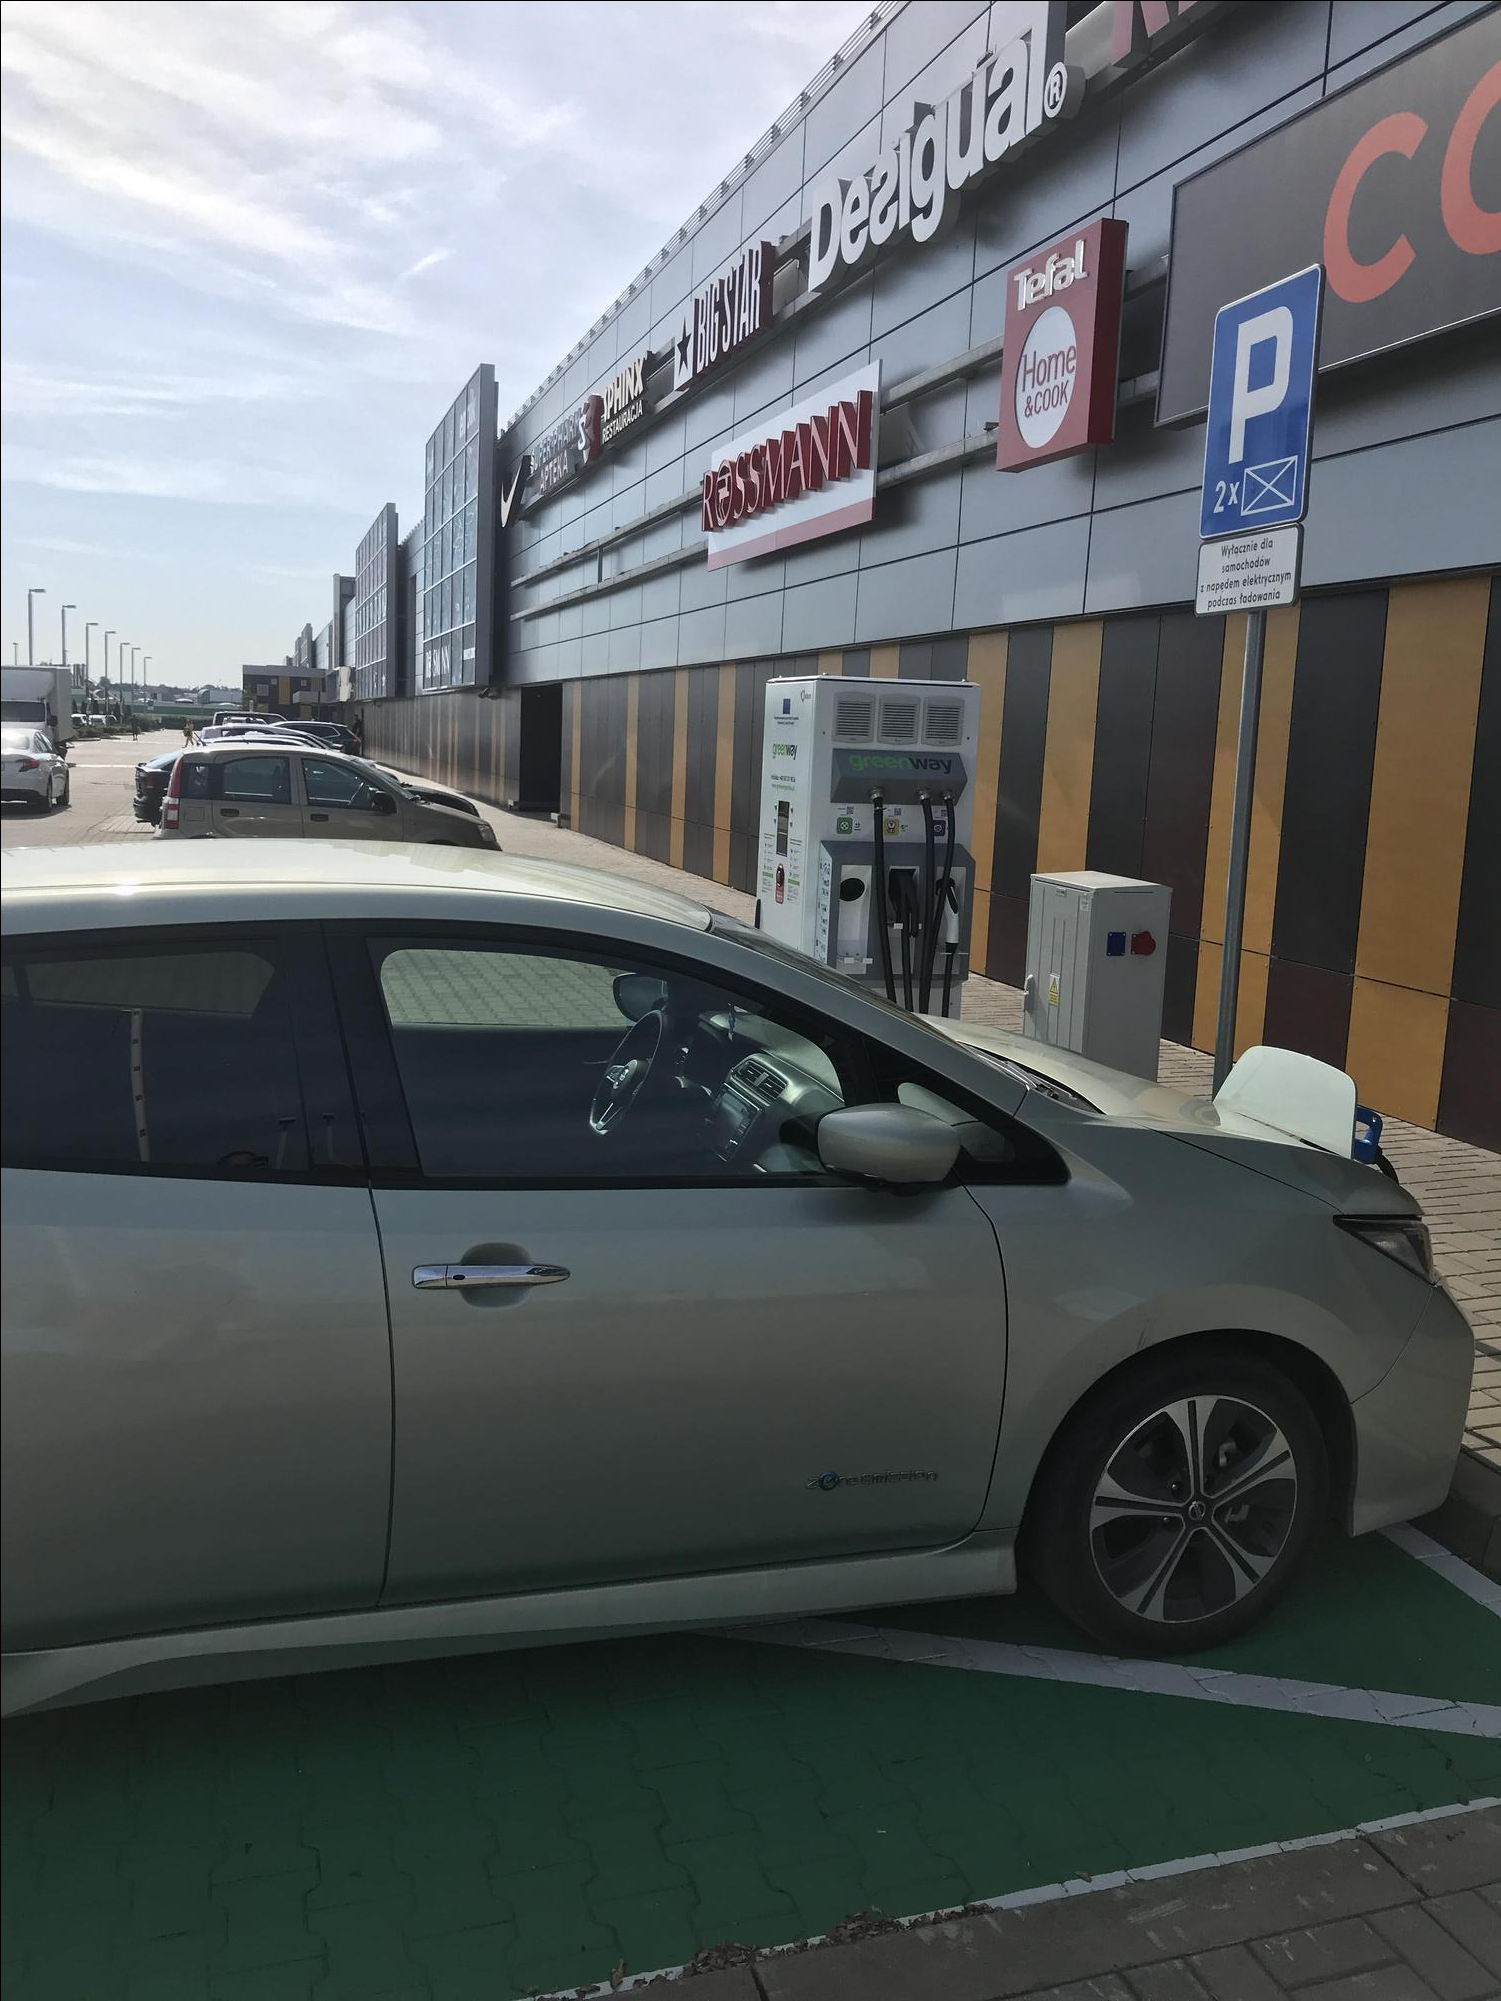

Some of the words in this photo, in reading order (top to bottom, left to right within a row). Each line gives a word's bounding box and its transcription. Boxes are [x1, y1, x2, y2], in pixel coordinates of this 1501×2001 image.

[1013, 239, 1089, 311] Tefal
[697, 282, 720, 374] BIG
[722, 241, 763, 353] STAR
[1021, 345, 1077, 393] Home
[1228, 306, 1293, 464] P
[1023, 380, 1069, 418] &COOK
[602, 400, 643, 444] RESTAURACJA
[702, 390, 868, 531] ROSSMANN
[1221, 541, 1258, 558] Wyłącznie
[1260, 537, 1273, 550] dla
[1221, 555, 1271, 573] samochodów
[1200, 584, 1204, 593] z
[1206, 578, 1240, 595] napędem
[1242, 572, 1292, 588] elektrycznym
[1207, 596, 1237, 611] podczas
[1239, 588, 1281, 604] ładowania
[772, 744, 798, 760] greenway
[849, 754, 952, 775] greenway
